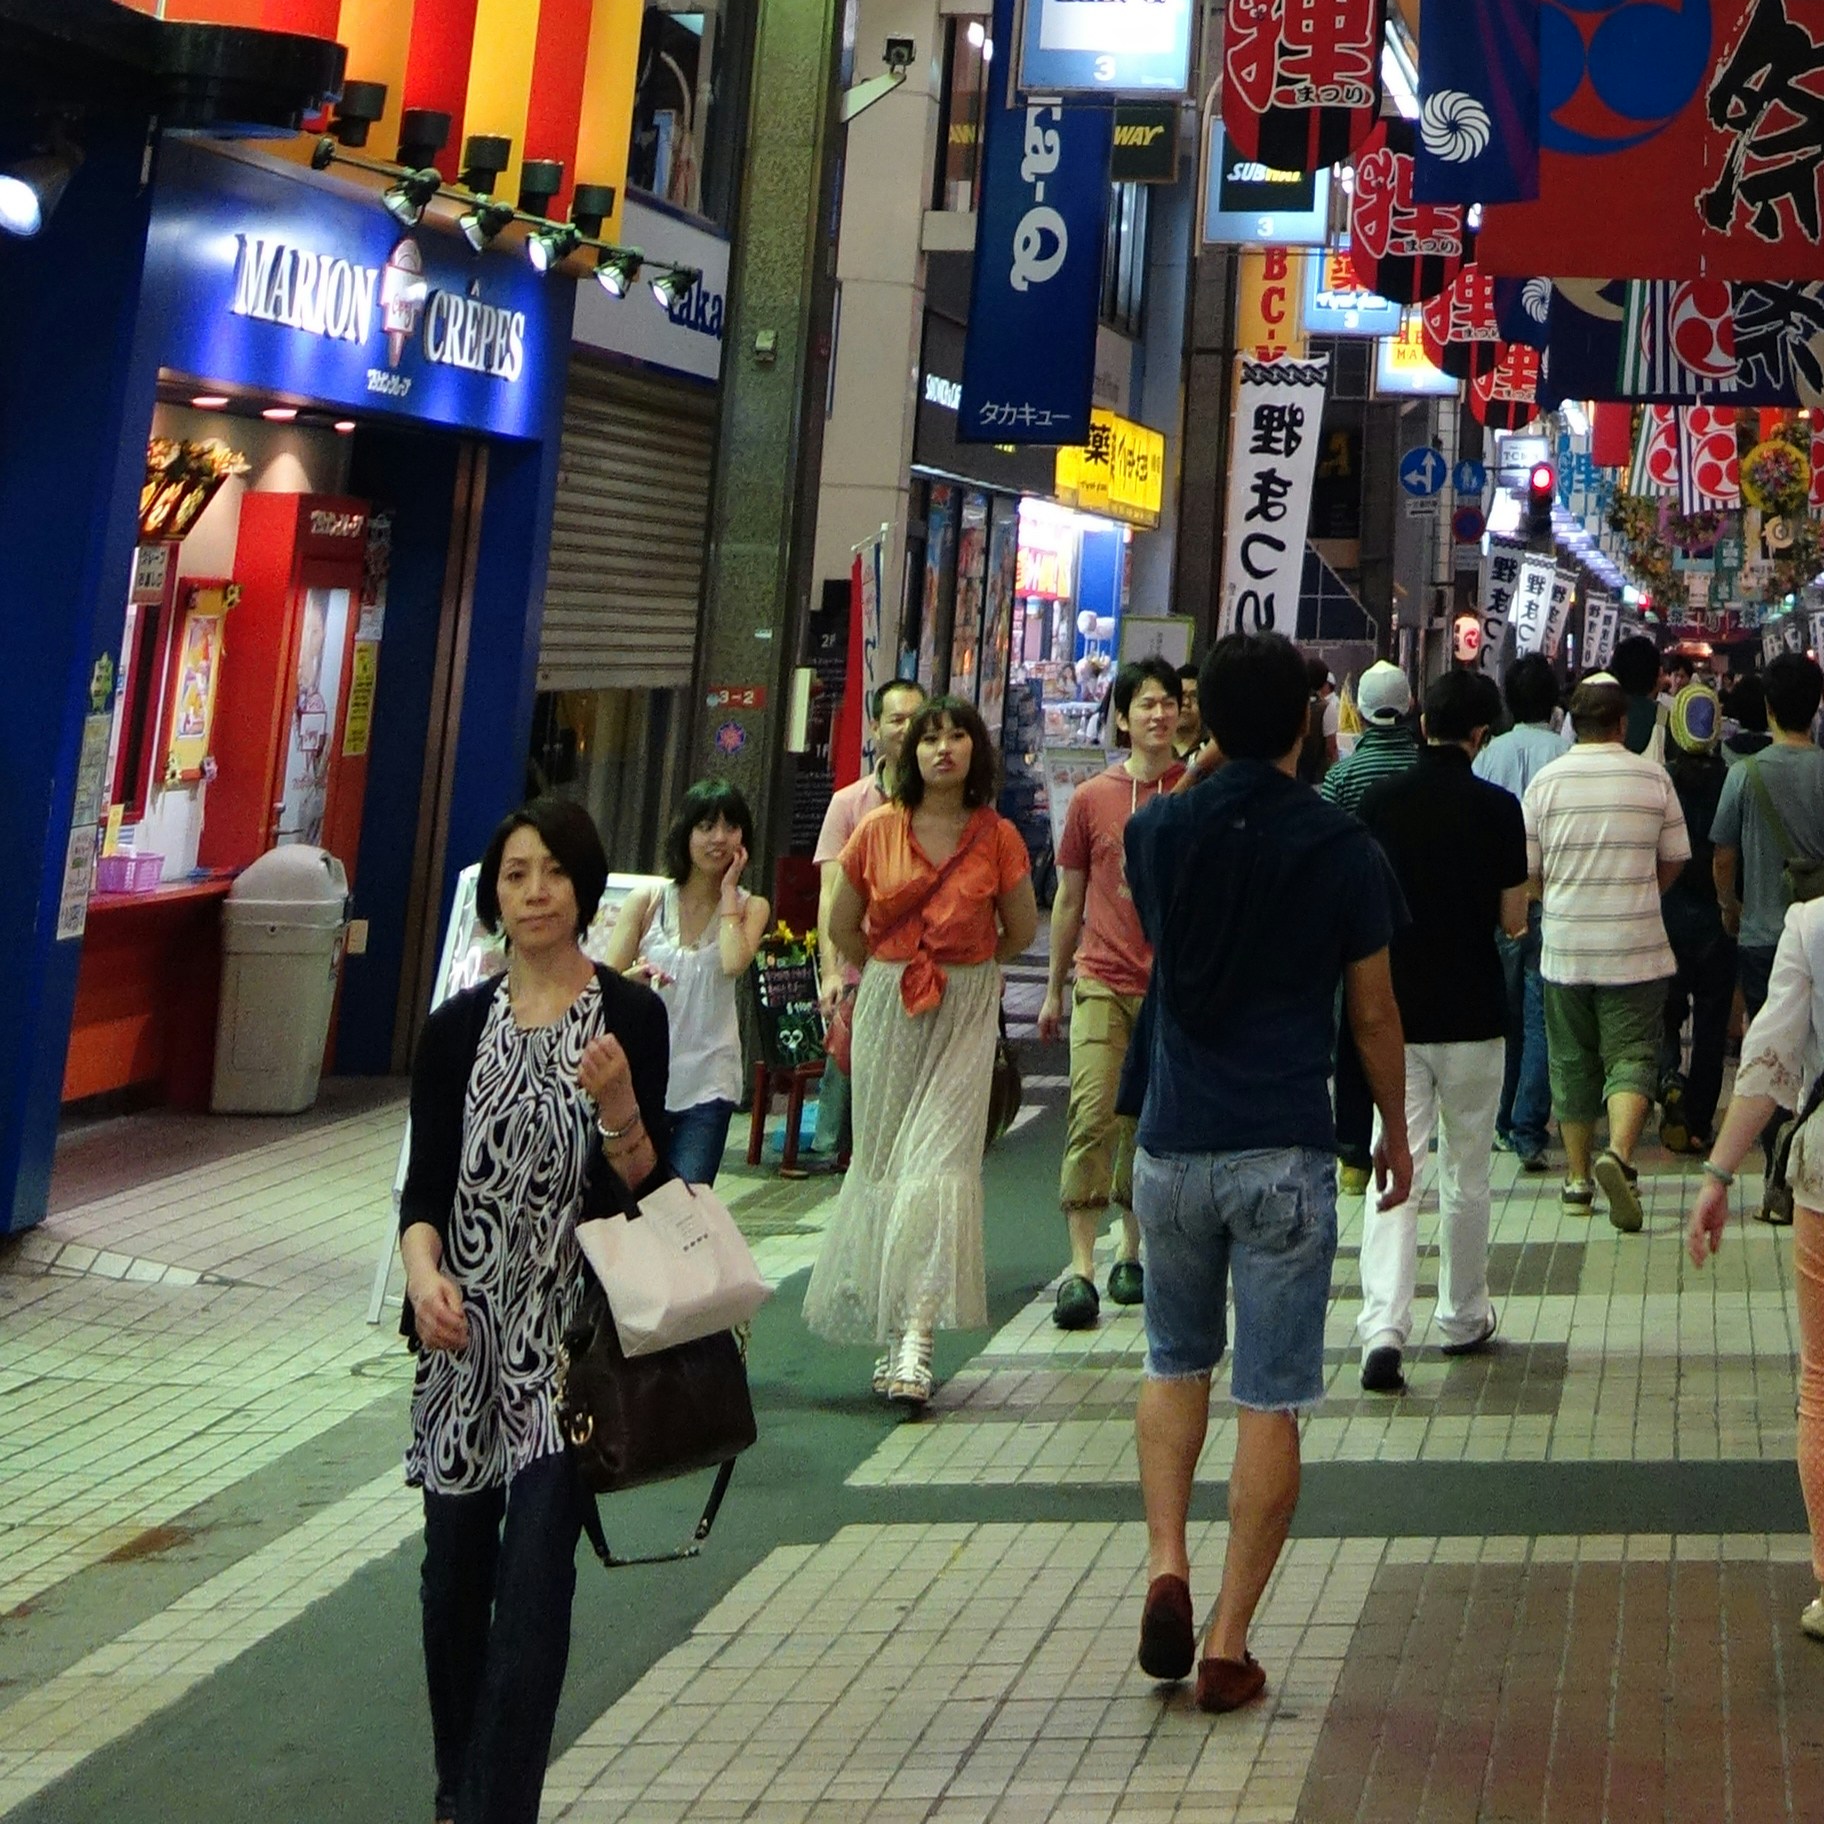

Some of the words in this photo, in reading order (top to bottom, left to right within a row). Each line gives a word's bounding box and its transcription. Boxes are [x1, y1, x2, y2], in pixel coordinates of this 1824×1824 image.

[1093, 56, 1116, 81] 3
[1296, 84, 1364, 102] まつり
[1257, 217, 1274, 237] 3
[230, 233, 379, 346] MARION
[978, 400, 1071, 427] タカキュー
[718, 690, 755, 705] 3-2
